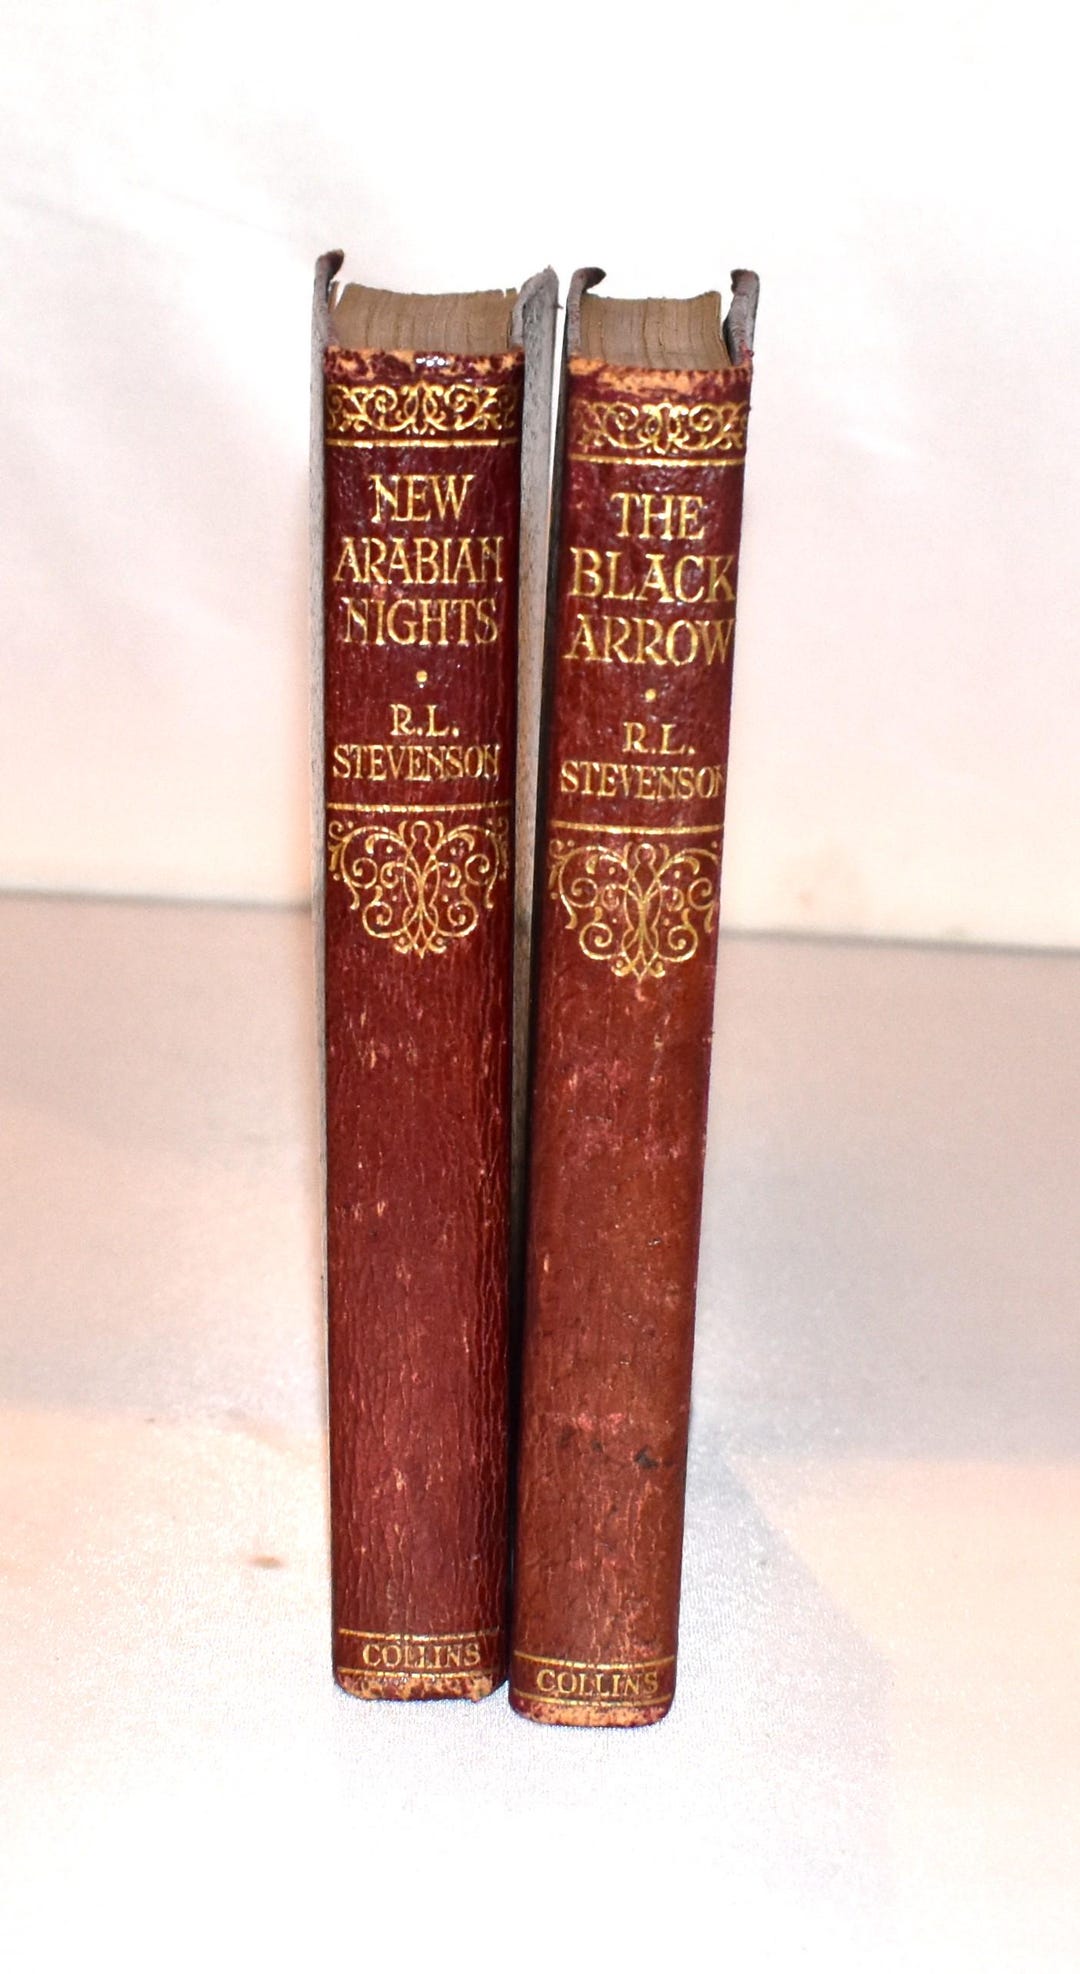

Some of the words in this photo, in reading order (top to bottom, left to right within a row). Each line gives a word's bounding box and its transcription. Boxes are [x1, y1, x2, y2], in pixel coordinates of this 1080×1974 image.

[369, 473, 475, 523] NEW
[610, 491, 706, 541] THE
[333, 536, 504, 585] ARABIAN
[568, 546, 737, 603] BLACK
[340, 597, 499, 646] NIGHTS
[563, 613, 736, 667] ARROW
[390, 704, 460, 737] R.L.
[622, 722, 696, 755] R.L.
[332, 743, 500, 782] STEVENSON
[362, 1642, 481, 1670] COLLINS
[536, 1668, 658, 1697] COLLINS
